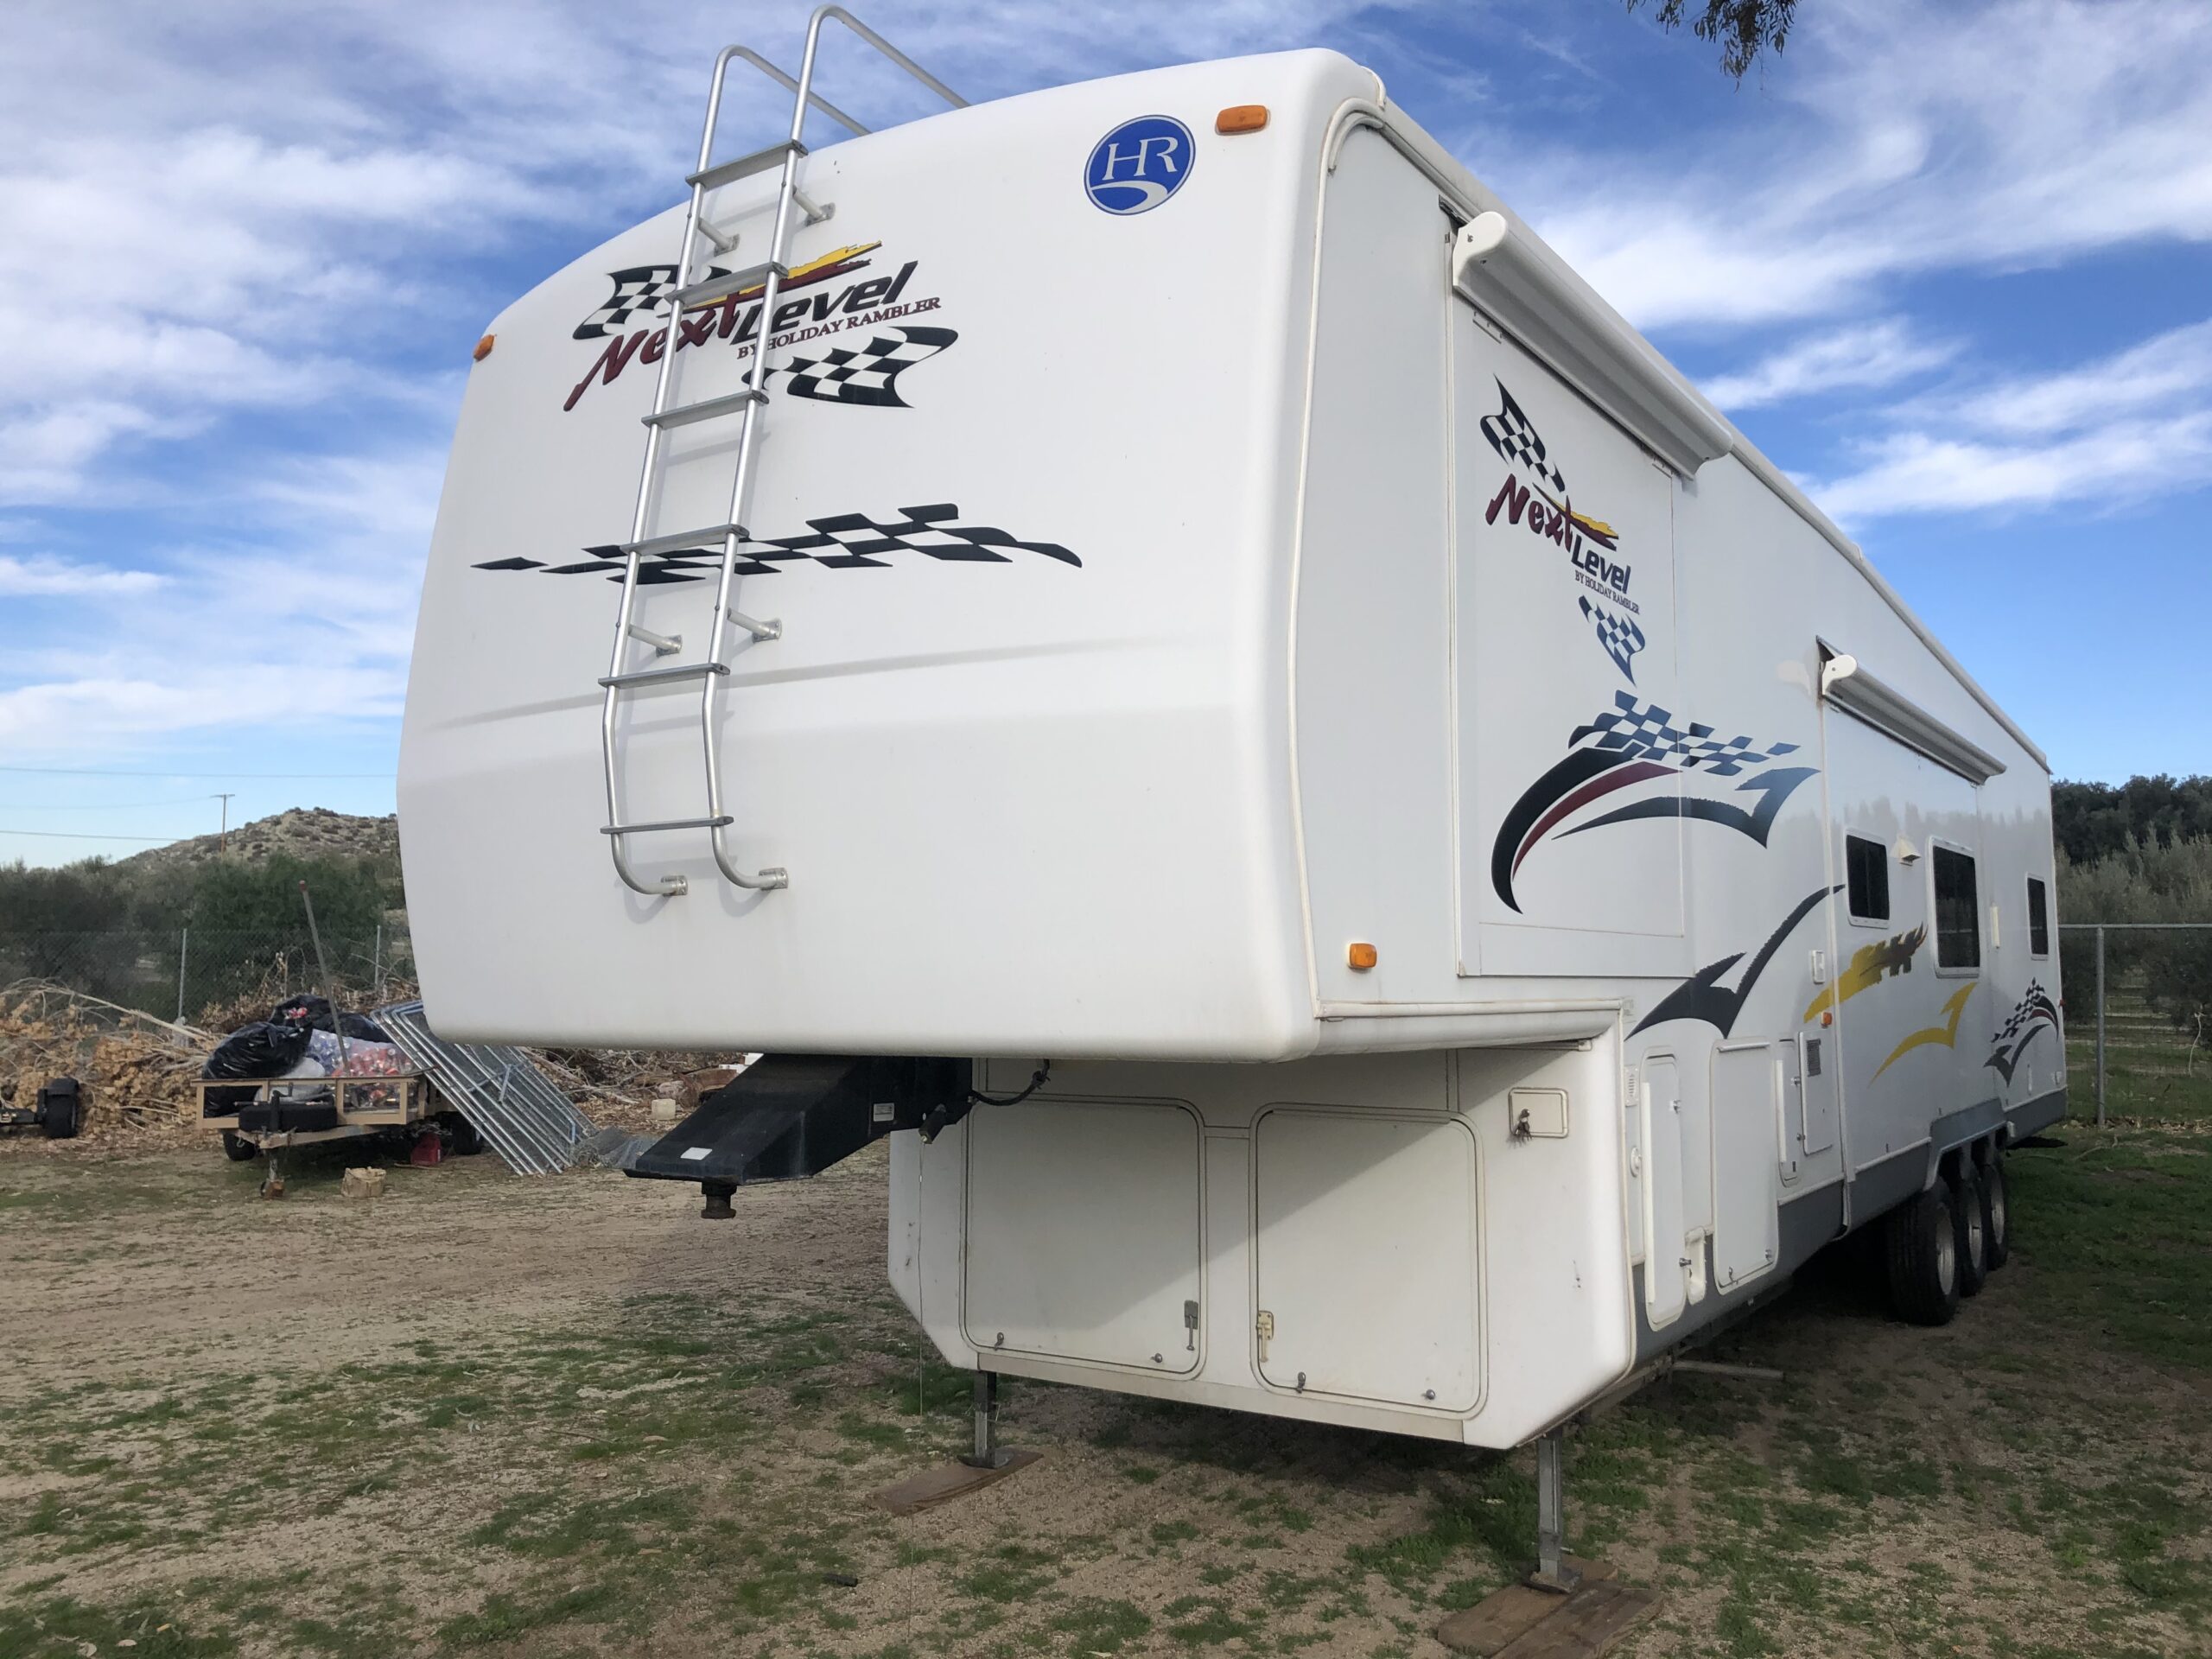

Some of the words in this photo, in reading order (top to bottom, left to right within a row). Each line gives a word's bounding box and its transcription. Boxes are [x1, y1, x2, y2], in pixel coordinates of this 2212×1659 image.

[1102, 137, 1179, 181] HR
[729, 260, 918, 346] Level
[767, 320, 843, 351] HOLIDAY
[846, 296, 942, 330] RAMBLER
[1485, 474, 1573, 553] Next
[1571, 534, 1631, 594] Level
[1574, 569, 1584, 584] BY
[1585, 575, 1612, 600] HOLIDAY
[1611, 591, 1640, 615] RAMBLER
